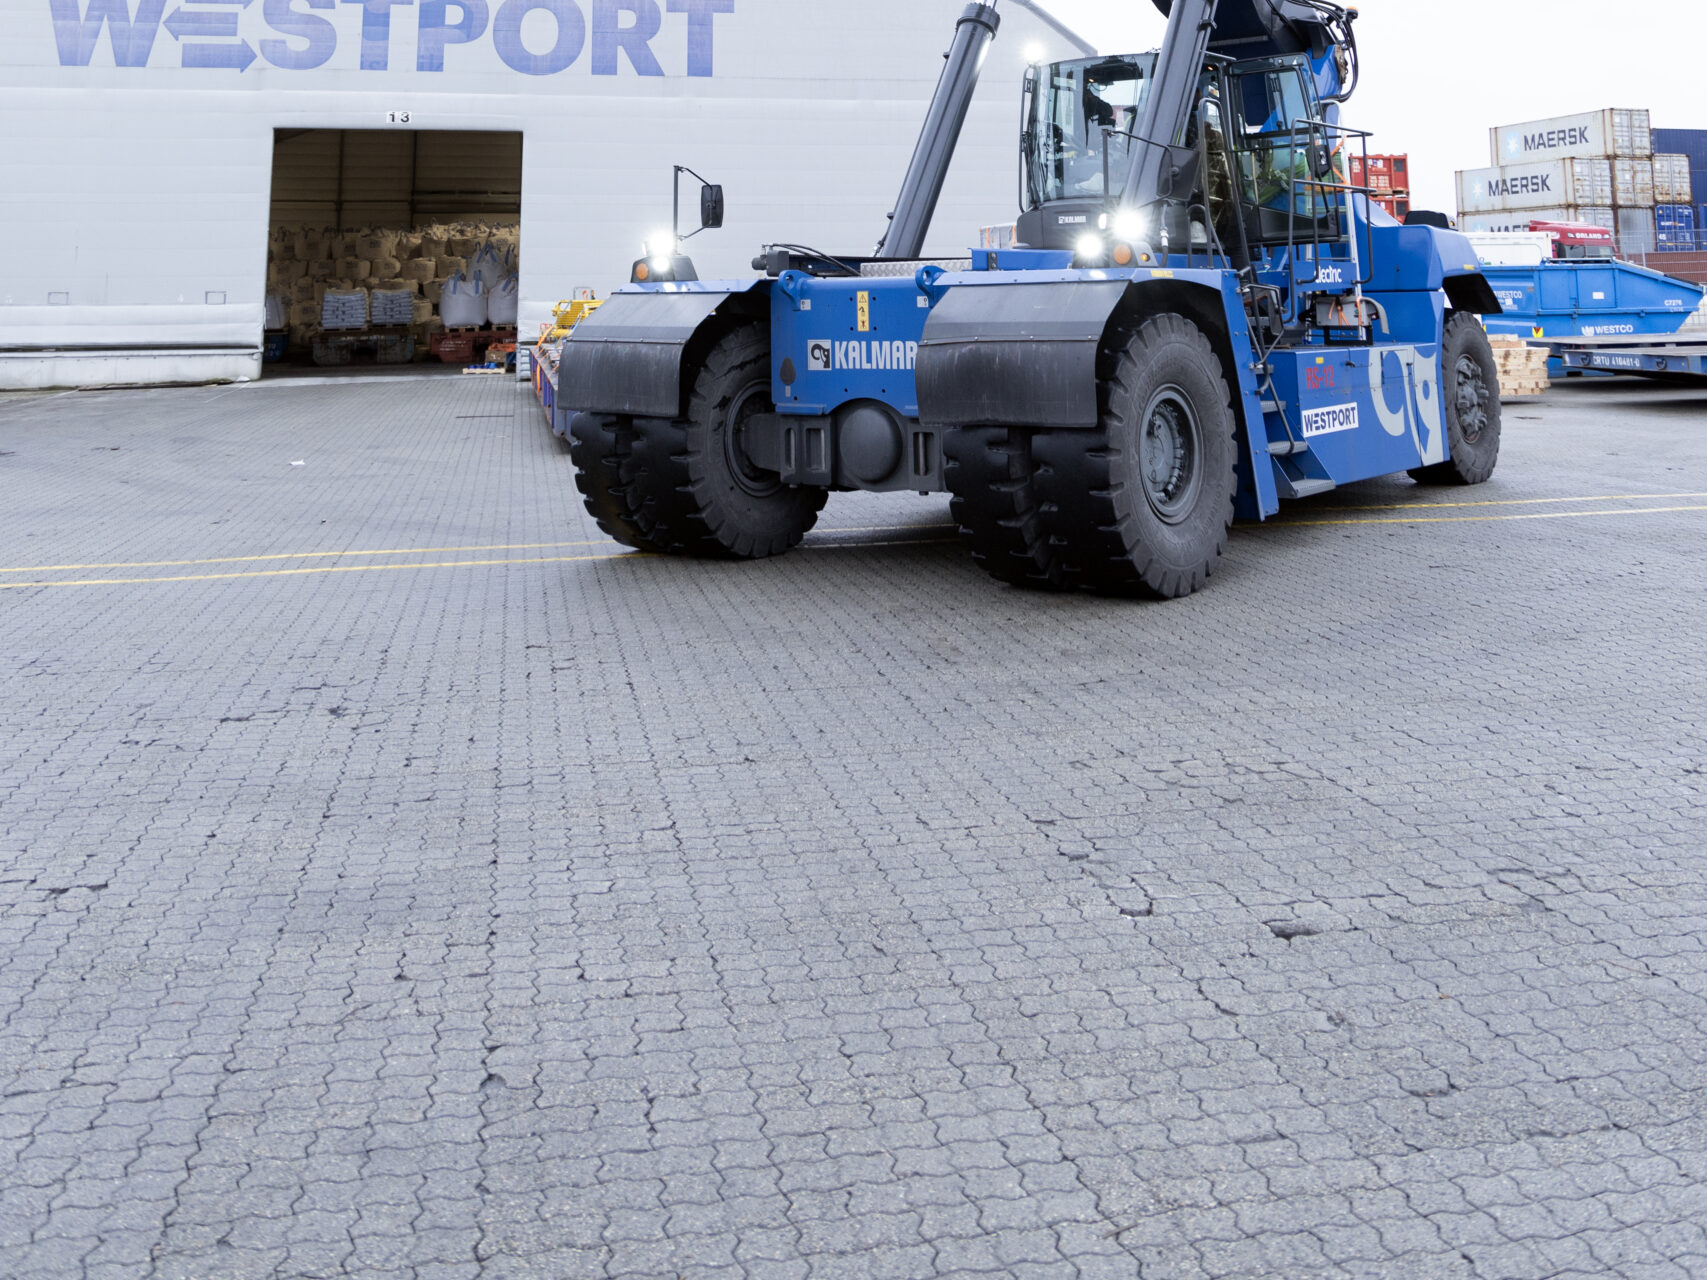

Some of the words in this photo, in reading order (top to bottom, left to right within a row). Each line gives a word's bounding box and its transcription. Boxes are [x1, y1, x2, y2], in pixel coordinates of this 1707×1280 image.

[388, 111, 410, 123] 13
[1523, 126, 1590, 151] MAERSK
[1488, 174, 1551, 197] MAERSK
[1594, 324, 1634, 334] WESTCO
[834, 340, 918, 370] KALMAR
[1306, 365, 1336, 389] RS-12
[1303, 406, 1356, 433] WESTPORT
